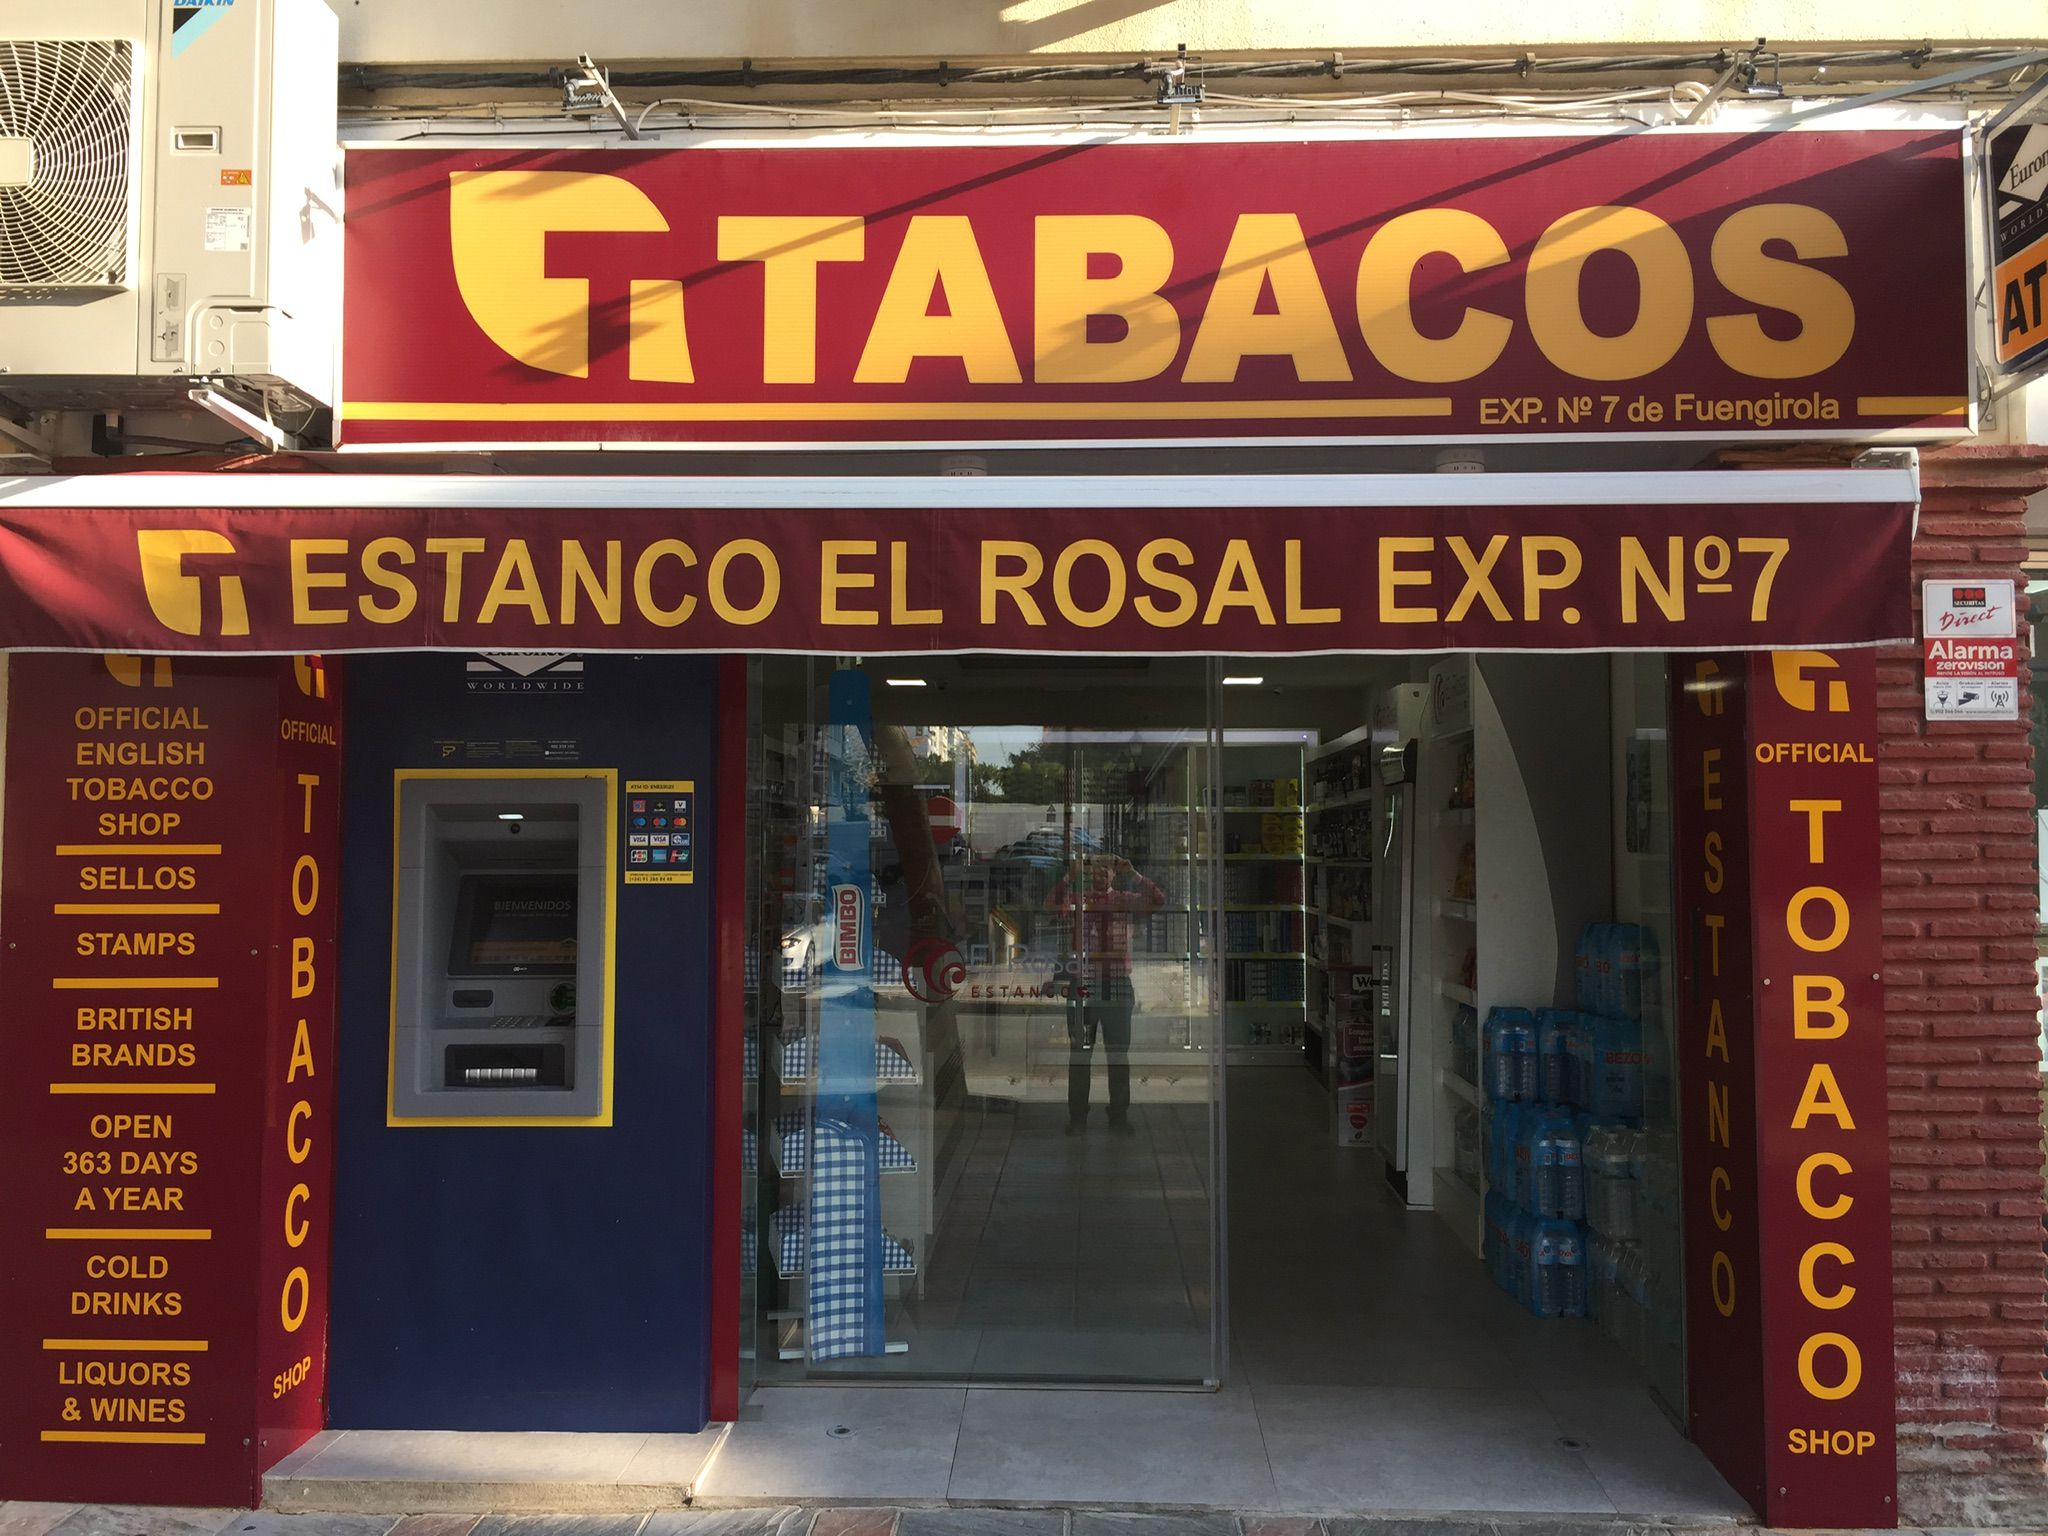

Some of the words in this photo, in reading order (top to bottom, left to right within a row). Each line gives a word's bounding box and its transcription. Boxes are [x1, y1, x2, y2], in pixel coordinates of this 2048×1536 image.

[2000, 203, 2048, 243] WORLD
[717, 204, 1855, 384] TABACOS
[1480, 397, 1546, 424] EXP.
[1557, 396, 1593, 423] Nº
[1600, 395, 1620, 423] 7
[1627, 395, 1664, 423] de
[1674, 392, 1840, 427] Fuengirola
[290, 536, 781, 627] ESTANCO
[821, 540, 943, 626] EL
[980, 538, 1341, 628] ROSAL
[1379, 535, 1582, 624] EXP.
[1939, 606, 2001, 631] Direct
[1928, 639, 2013, 660] Alarma
[1936, 661, 2005, 671] zerovision
[467, 682, 585, 690] WORLDWIDE
[75, 706, 209, 730] OFFICIAL
[281, 719, 336, 746] OFFICIAL
[76, 742, 205, 766] ENGLISH
[1755, 742, 1874, 764] OFFICIAL
[66, 777, 214, 801] TOBACCO
[99, 812, 181, 836] SHOP
[80, 866, 196, 890] SELLOS
[494, 901, 572, 911] BIENVENIDOS
[840, 889, 857, 964] BIMBO
[77, 932, 196, 956] STAMPS
[971, 943, 996, 972] El
[1008, 942, 1088, 974] Rosal
[77, 1007, 192, 1030] BRITISH
[1702, 748, 1737, 1318] ESTANCO
[72, 1043, 196, 1067] BRANDS
[281, 774, 320, 1333] TOBACCO
[1606, 1052, 1652, 1065] BEZO
[1787, 799, 1862, 1400] TOBACCO
[90, 1115, 172, 1139] OPEN
[63, 1151, 111, 1175] 363
[121, 1151, 198, 1175] DAYS
[74, 1187, 96, 1211] A
[103, 1187, 184, 1211] YEAR
[87, 1255, 169, 1279] COLD
[72, 1291, 182, 1316] DRINKS
[59, 1361, 191, 1386] LIQUORS
[273, 1356, 312, 1400] SHOP
[62, 1397, 82, 1422] &
[91, 1397, 186, 1423] WINES
[1788, 1428, 1876, 1456] SHOP
